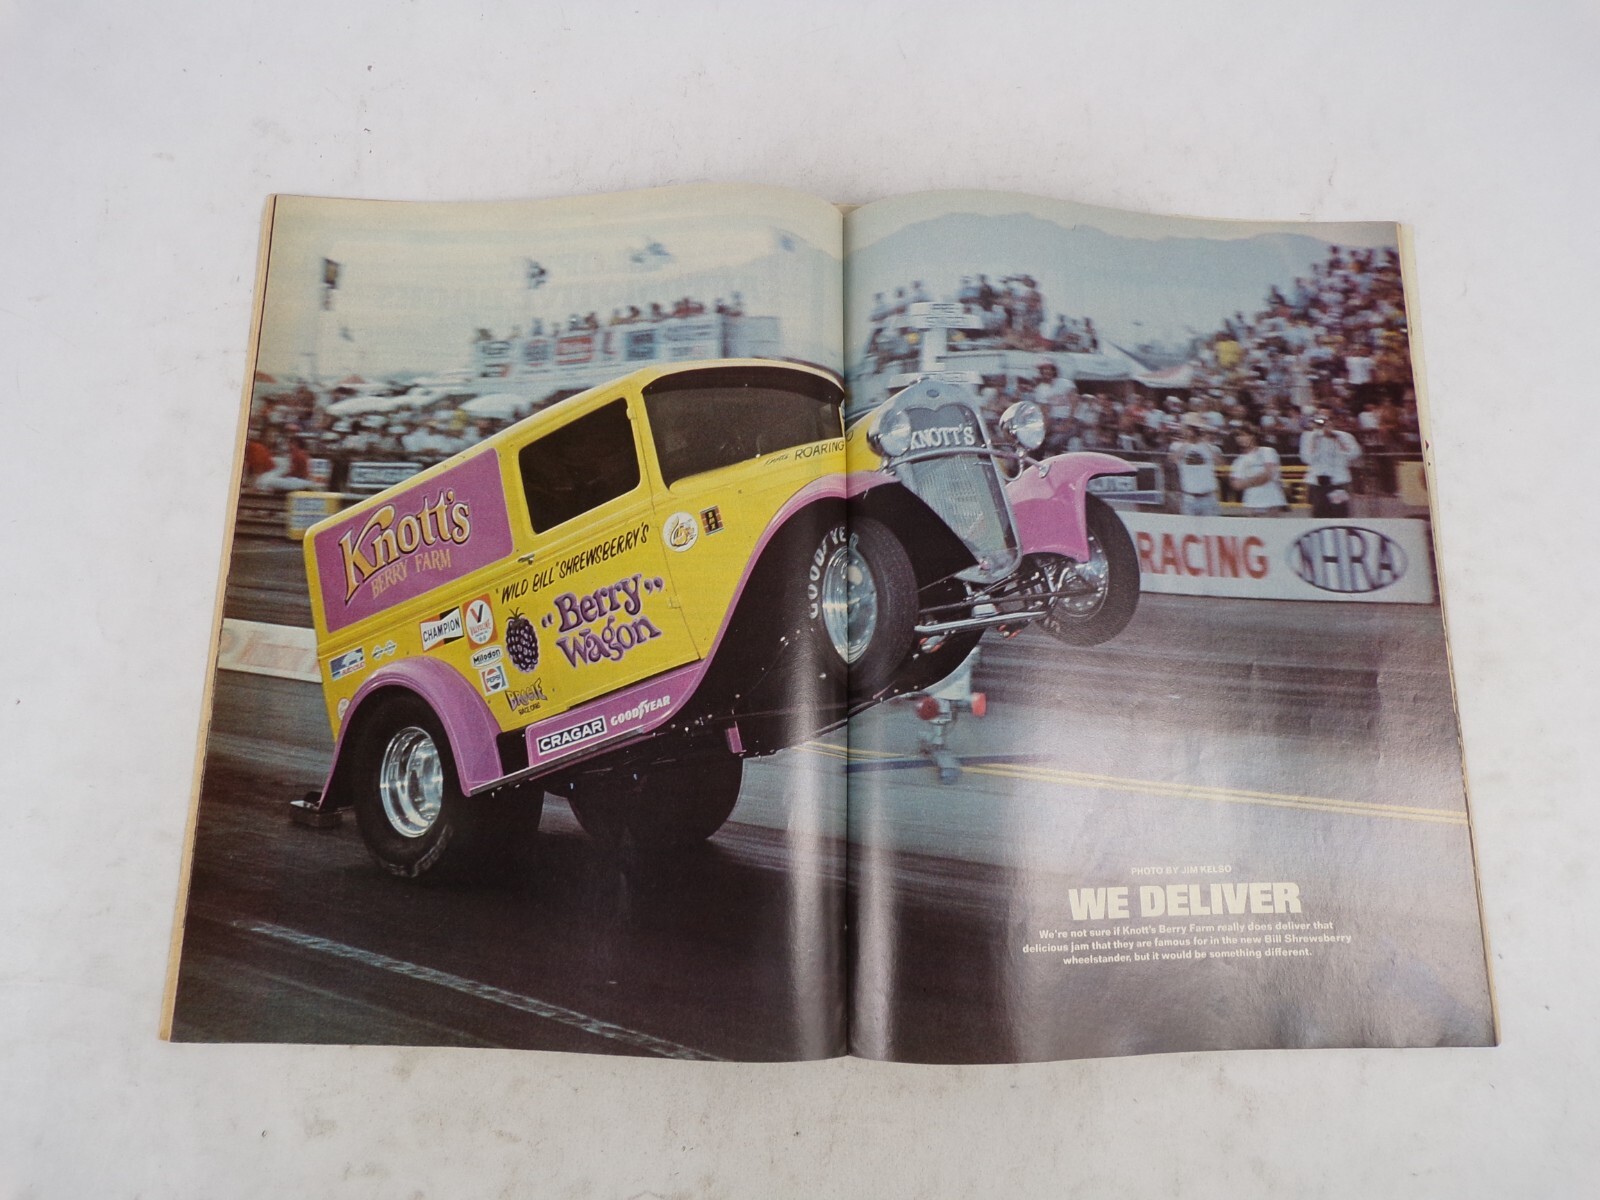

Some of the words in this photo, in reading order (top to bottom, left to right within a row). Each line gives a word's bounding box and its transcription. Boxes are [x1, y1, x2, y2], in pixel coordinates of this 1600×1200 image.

[795, 441, 845, 460] ROARING
[910, 425, 975, 450] KNOTT'S
[338, 490, 471, 605] Knott's
[559, 522, 649, 579] SHREWSBERRY'S
[1135, 531, 1271, 579] RACING
[1295, 527, 1404, 592] NHRA
[371, 559, 409, 598] BERRY
[415, 548, 452, 573] FARM
[422, 618, 460, 642] CHAMPION
[556, 616, 662, 668] Wagon
[473, 648, 500, 664] Milodon
[540, 720, 603, 751] CRAGAR
[611, 695, 671, 727] GOODYEAR
[1131, 867, 1163, 876] PHOTO
[1166, 867, 1178, 875] BY
[1181, 866, 1198, 875] JIM
[1200, 865, 1232, 873] KELSO
[1068, 887, 1130, 921] WE
[1139, 882, 1302, 918] DELIVER
[1022, 943, 1069, 954] delicious
[1070, 942, 1089, 953] jam
[1092, 940, 1111, 950] that
[1113, 939, 1134, 951] they
[1154, 937, 1191, 947] famous
[1193, 936, 1207, 946] for
[1210, 935, 1220, 945] in
[1222, 935, 1238, 945] the
[1240, 936, 1262, 944] new
[1264, 934, 1282, 944] Bill
[1284, 933, 1352, 944] Shrewsberry
[1039, 929, 1068, 939] We're
[1070, 928, 1087, 938] not
[1089, 929, 1111, 937] sure
[1113, 926, 1120, 936] if
[1122, 925, 1156, 935] Knott's
[1159, 924, 1187, 935] Berry
[1189, 923, 1215, 932] Farm
[1217, 922, 1245, 933] really
[1248, 921, 1273, 931] does
[1275, 920, 1310, 930] deliver
[1313, 920, 1334, 929] that
[1063, 954, 1132, 965] wheelstander,
[1134, 952, 1150, 962] but
[1152, 951, 1159, 961] it
[1161, 950, 1192, 960] would
[1194, 949, 1207, 959] be
[1209, 947, 1262, 959] something
[1264, 947, 1313, 957] different.
